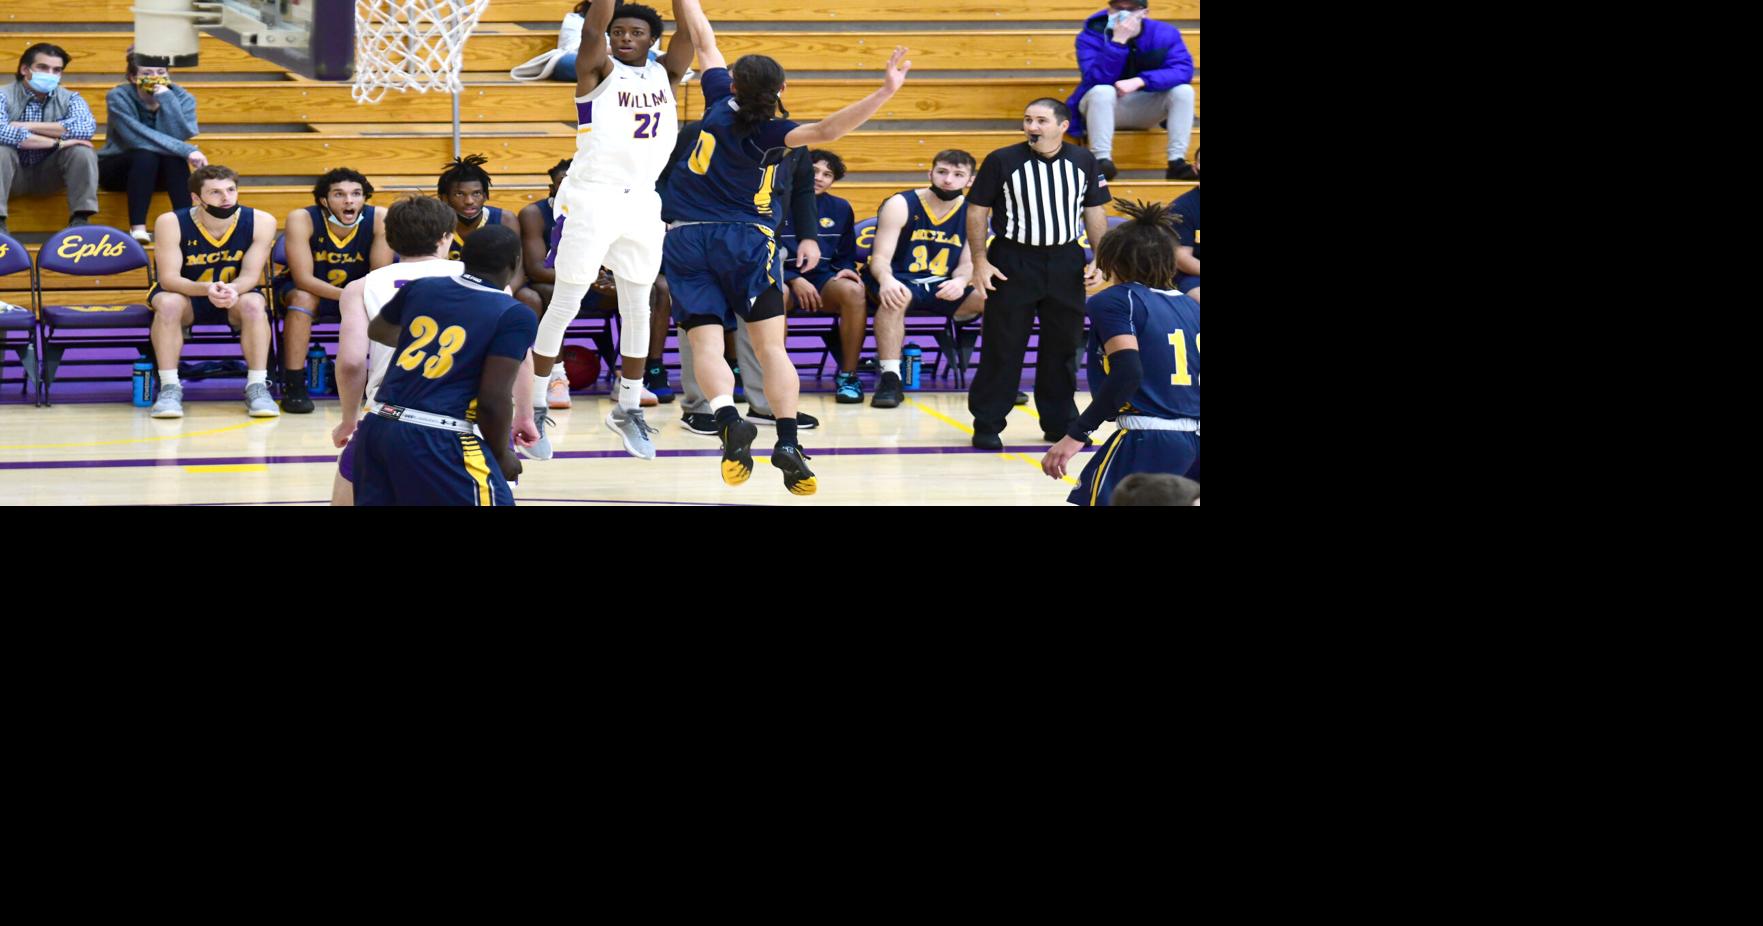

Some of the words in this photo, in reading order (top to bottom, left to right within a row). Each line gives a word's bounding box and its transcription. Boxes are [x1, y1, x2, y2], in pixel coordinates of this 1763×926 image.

[57, 234, 126, 263] Ephs
[910, 229, 962, 247] MCLA
[908, 244, 950, 276] 34
[396, 315, 466, 379] 23
[1167, 328, 1200, 386] 1
